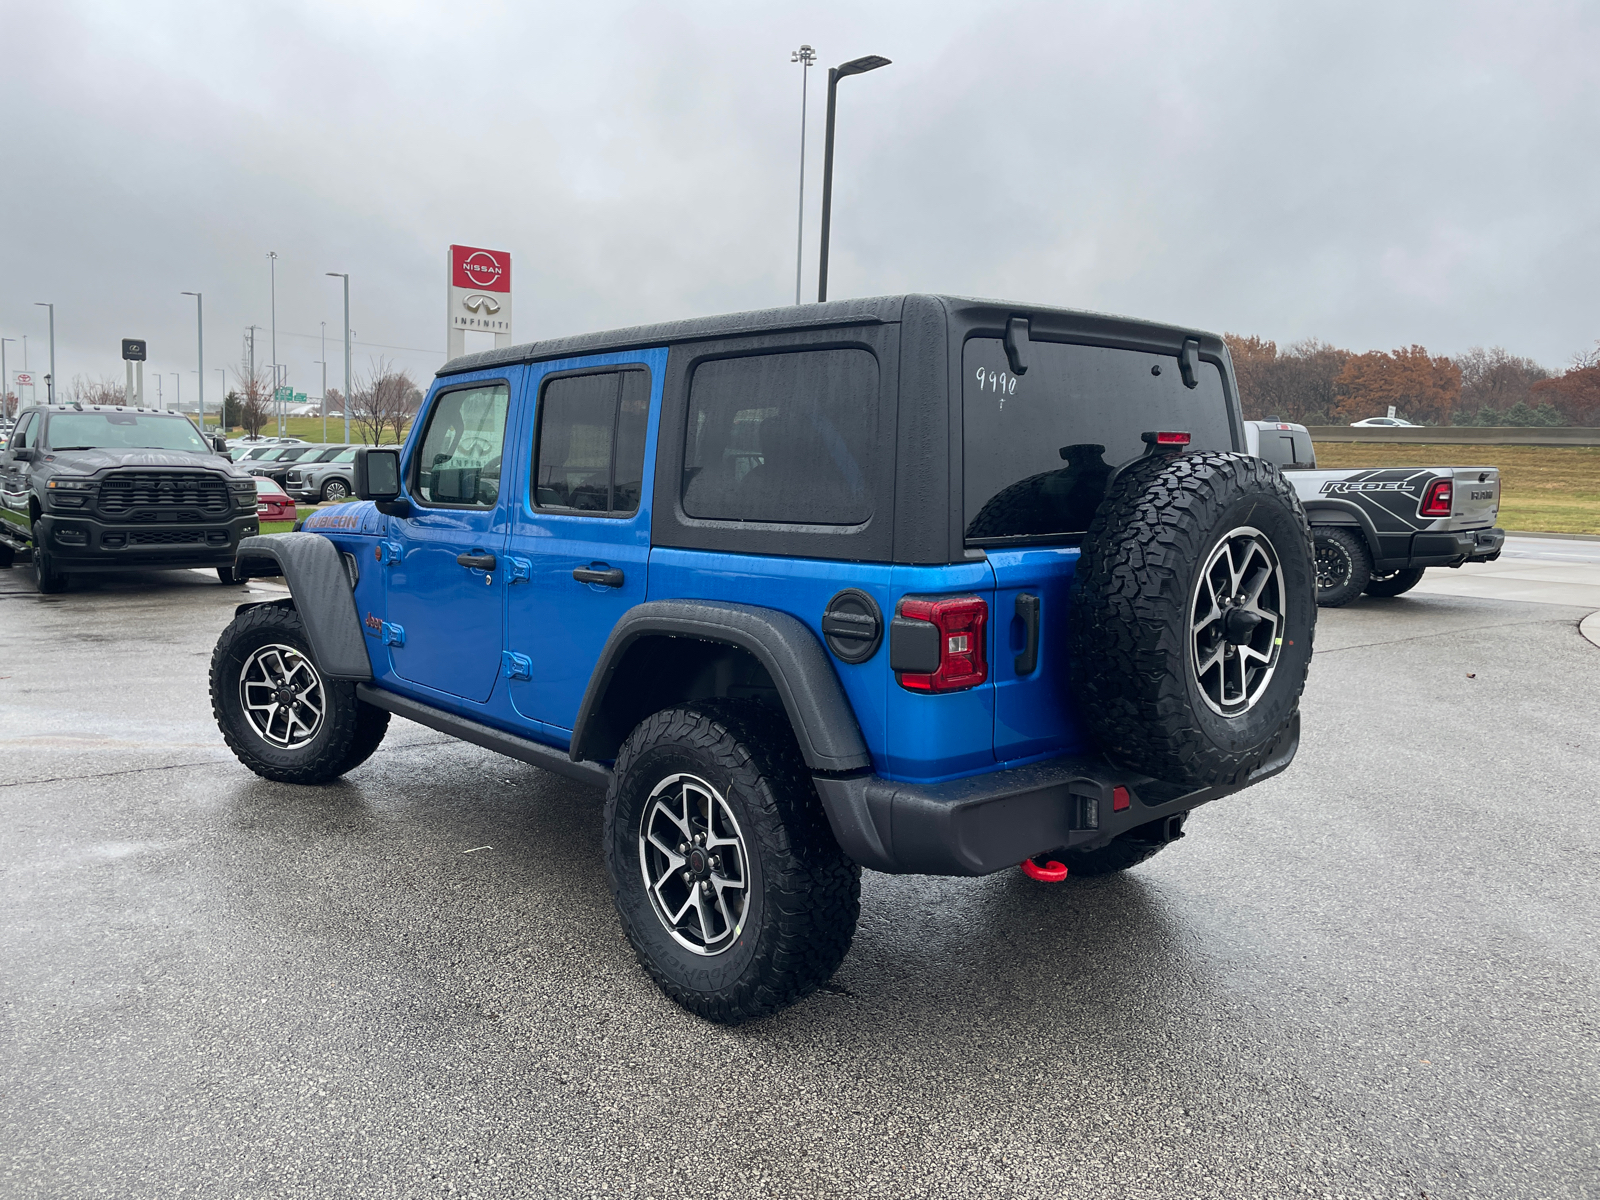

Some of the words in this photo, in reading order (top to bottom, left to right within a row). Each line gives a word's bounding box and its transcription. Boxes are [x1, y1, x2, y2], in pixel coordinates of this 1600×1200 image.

[463, 263, 502, 274] NISSAN
[455, 316, 509, 329] INFINITI
[134, 481, 198, 490] RAM
[1319, 481, 1415, 494] REBEL
[1471, 490, 1494, 500] RAM
[305, 514, 360, 529] RUBICON
[365, 612, 383, 634] Jeep
